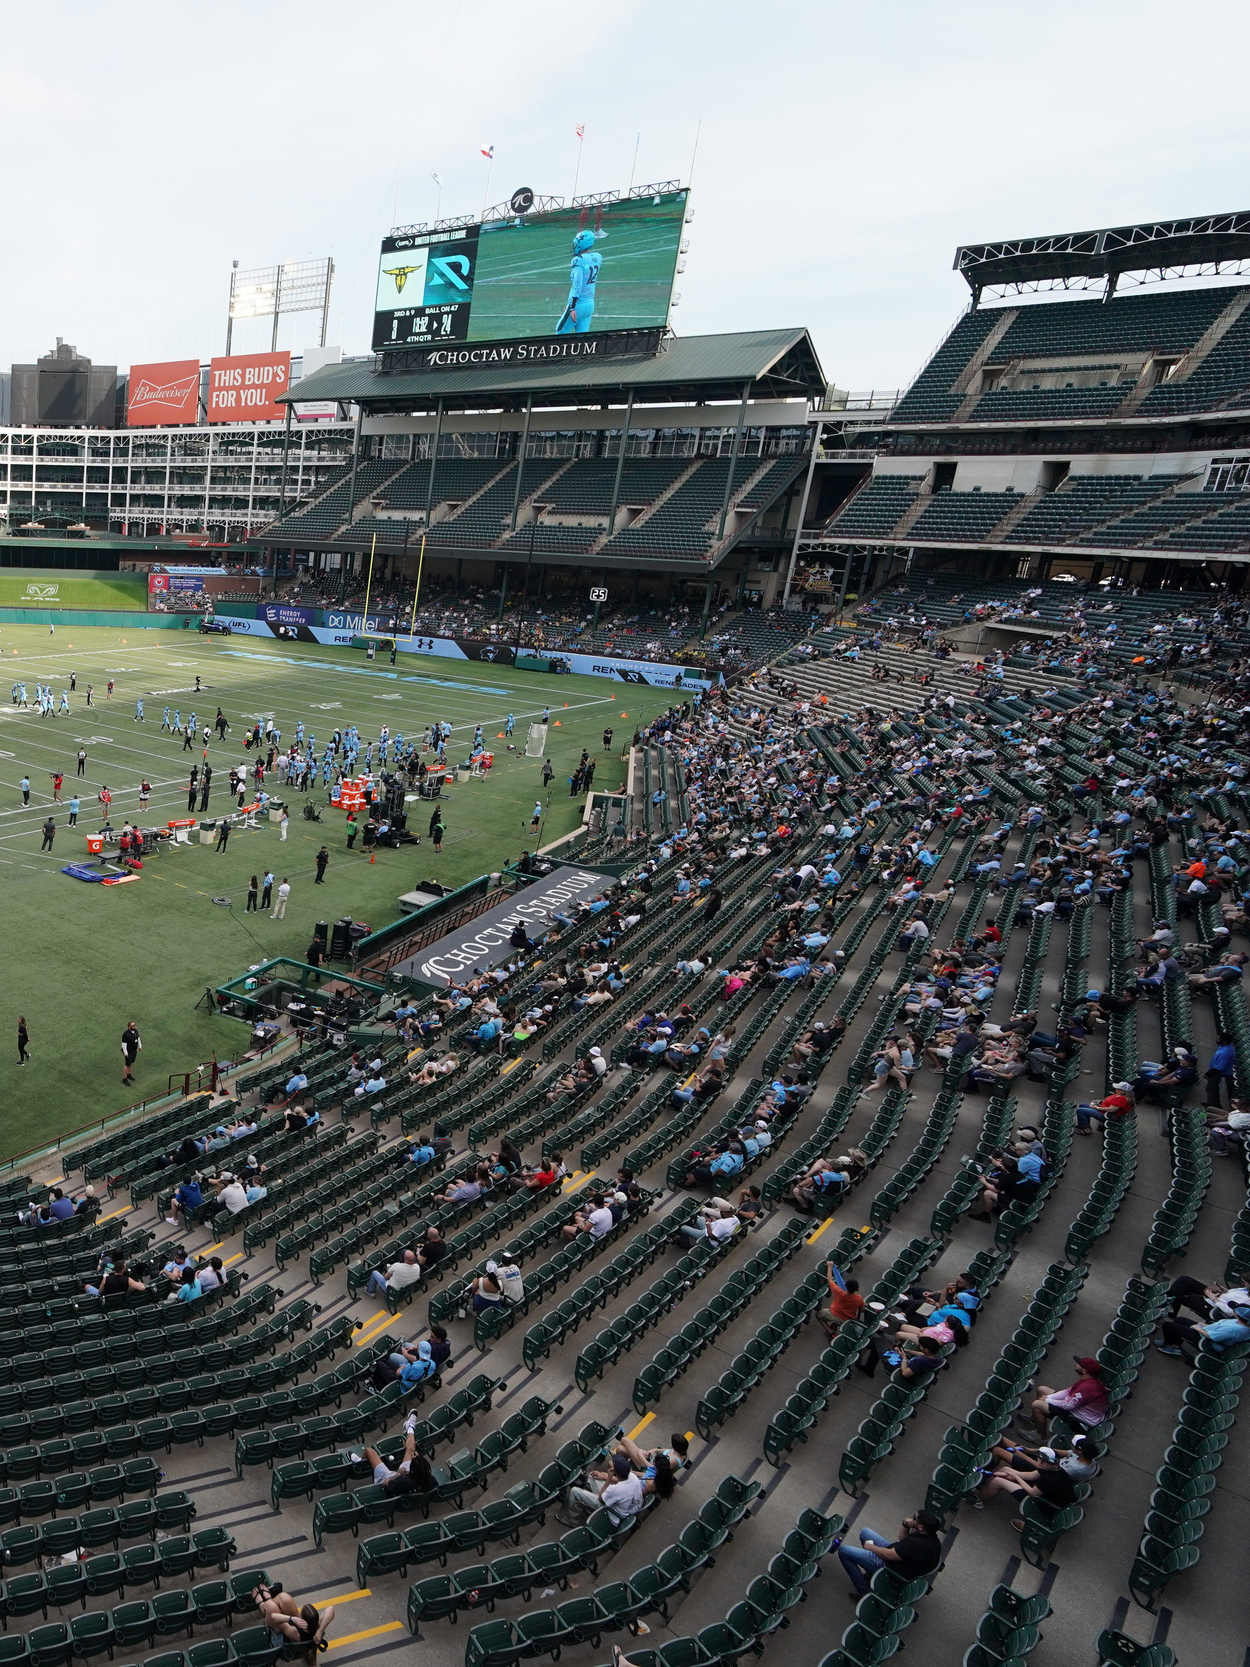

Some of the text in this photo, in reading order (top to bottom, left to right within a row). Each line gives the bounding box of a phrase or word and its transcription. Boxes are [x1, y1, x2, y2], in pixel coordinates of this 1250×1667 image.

[450, 230, 467, 240] LEAGUE
[391, 320, 398, 340] 3
[440, 314, 452, 335] 24
[434, 341, 598, 365] CHOCTAW STADIUM
[214, 368, 242, 387] THIS
[134, 386, 190, 401] Budweiser
[212, 388, 269, 408] FOR YOU.
[592, 590, 605, 599] 25
[280, 616, 305, 624] TRANSFER
[611, 662, 655, 671] ARLINGTON
[654, 679, 704, 690] RENEADES
[73, 736, 114, 745] 50
[426, 872, 601, 974] CHOCTAW STADIUM
